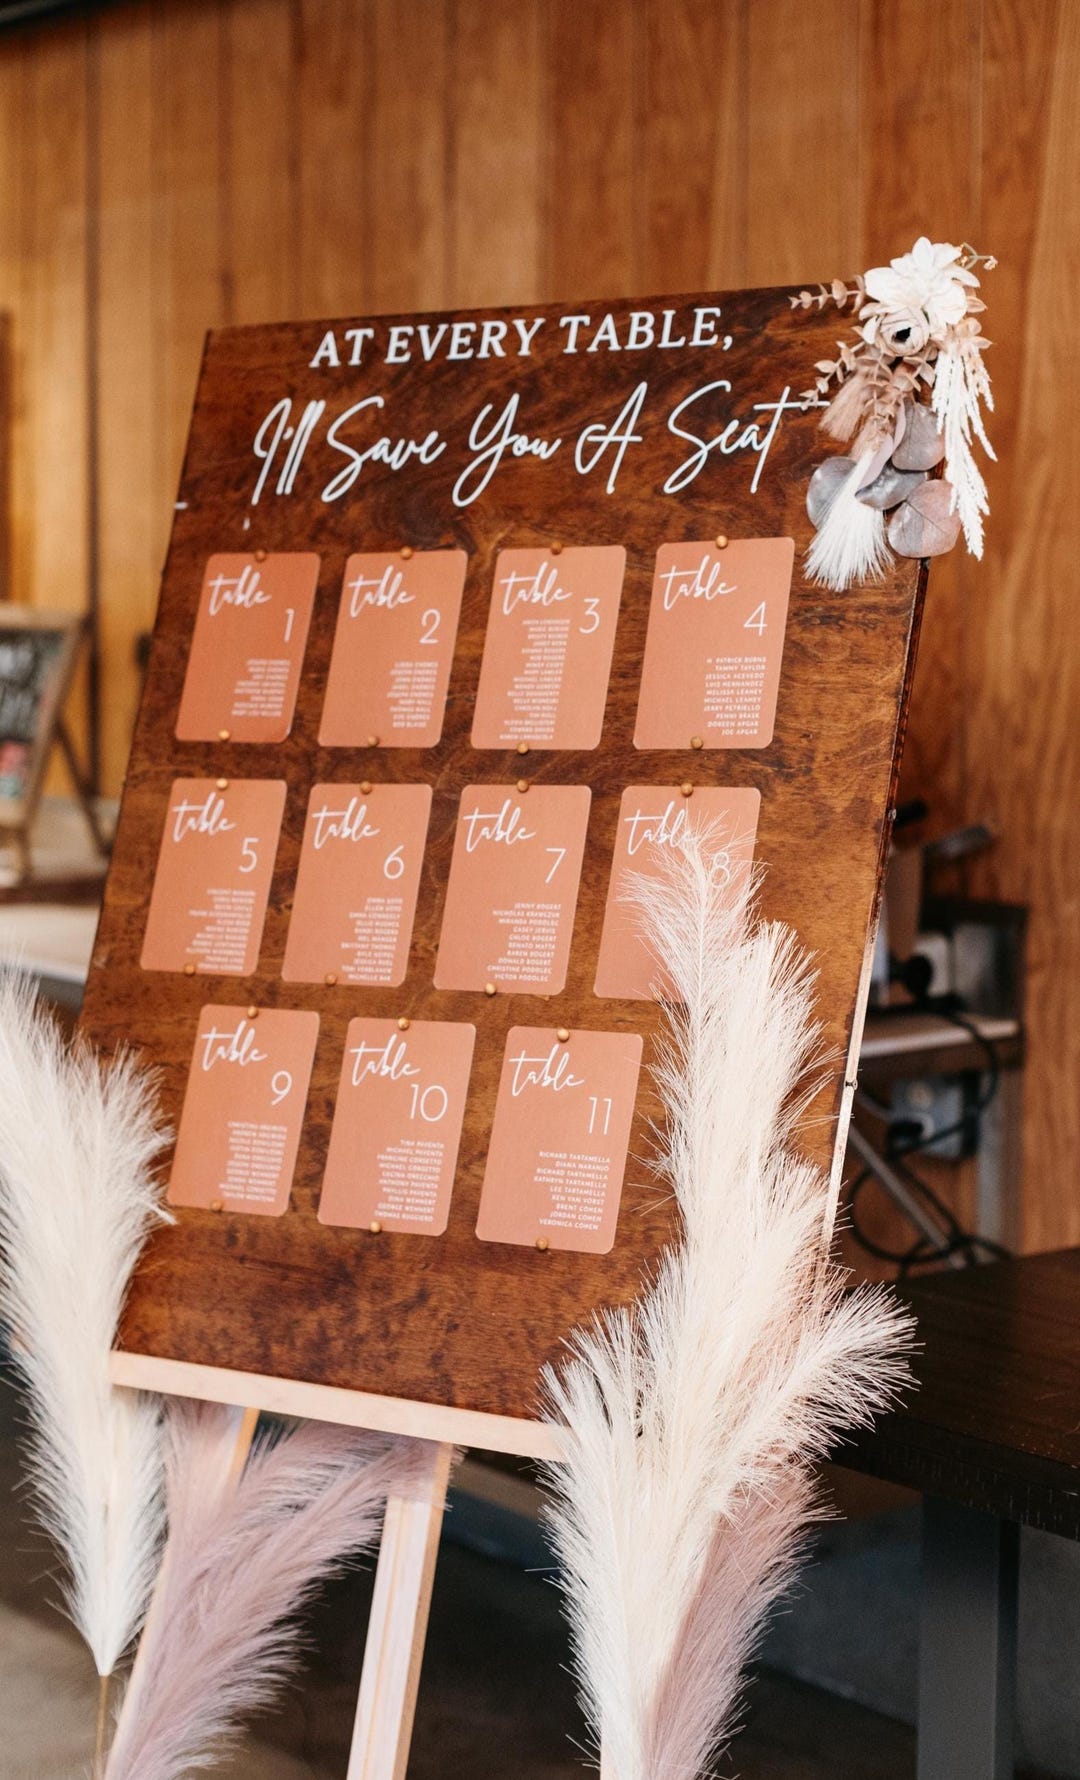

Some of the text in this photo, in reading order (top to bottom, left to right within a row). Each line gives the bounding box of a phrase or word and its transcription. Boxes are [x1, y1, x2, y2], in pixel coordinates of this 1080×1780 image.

[308, 307, 734, 368] AT EVERY TABLE,
[321, 396, 447, 503] Save
[452, 393, 562, 507] You
[574, 380, 647, 493] A
[663, 380, 830, 493] Seat
[208, 565, 272, 616] table
[349, 565, 416, 617] table
[500, 561, 573, 615] table
[659, 554, 737, 611] table
[284, 608, 295, 643] 1
[419, 609, 441, 644] 2
[579, 598, 600, 634] 3
[744, 601, 767, 636] 4
[172, 792, 236, 842] table
[312, 797, 380, 849] table
[463, 799, 537, 852] table
[238, 838, 259, 873] 5
[383, 845, 405, 880] 6
[545, 848, 566, 884] 7
[710, 852, 730, 888] 8
[202, 1020, 268, 1071] table
[350, 1033, 421, 1086] table
[270, 1070, 292, 1105] 9
[509, 1043, 584, 1097] table
[410, 1083, 448, 1122] 10
[589, 1097, 612, 1135] 11
[537, 1168, 608, 1180] RICHARD TARTAMELLA
[539, 1151, 610, 1163] RICHARD TARTAMELLA
[565, 1187, 605, 1197] TARTAMELLA
[566, 1179, 606, 1188] TARTAMELLA
[539, 1218, 599, 1230] VERONICA COHEN
[551, 1211, 601, 1222] JORDAN COHEN
